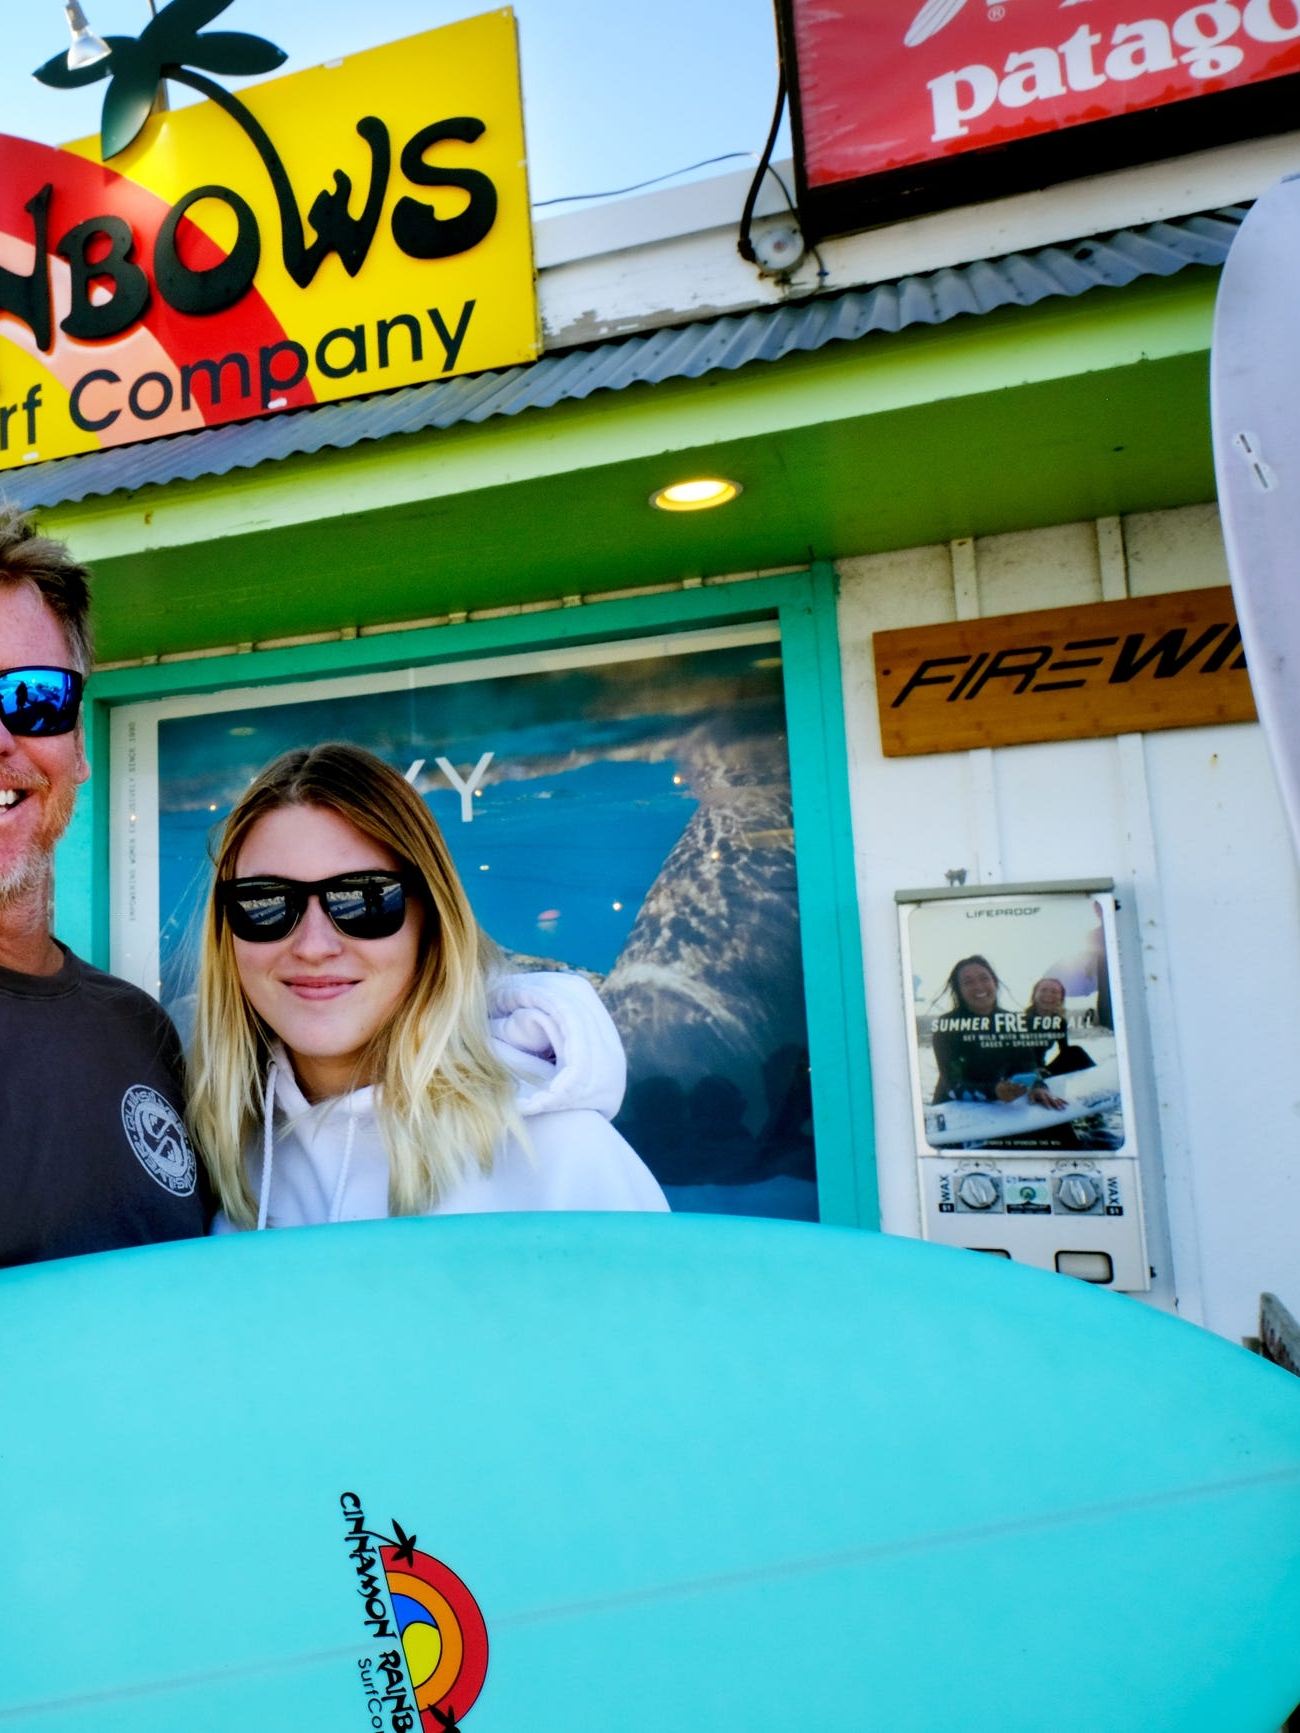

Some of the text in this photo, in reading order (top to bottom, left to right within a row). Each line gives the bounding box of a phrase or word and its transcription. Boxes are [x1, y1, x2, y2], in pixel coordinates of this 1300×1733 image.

[68, 300, 477, 432] Company
[890, 623, 1249, 708] FIREWI
[966, 906, 1041, 919] LIFEPROOF
[931, 1013, 1094, 1033] SUMMER FRE FOR ALL
[939, 1176, 951, 1202] WAX
[1107, 1177, 1120, 1205] WAX
[340, 1491, 398, 1639] CINNAMON
[358, 1658, 385, 1733] Surf Co
